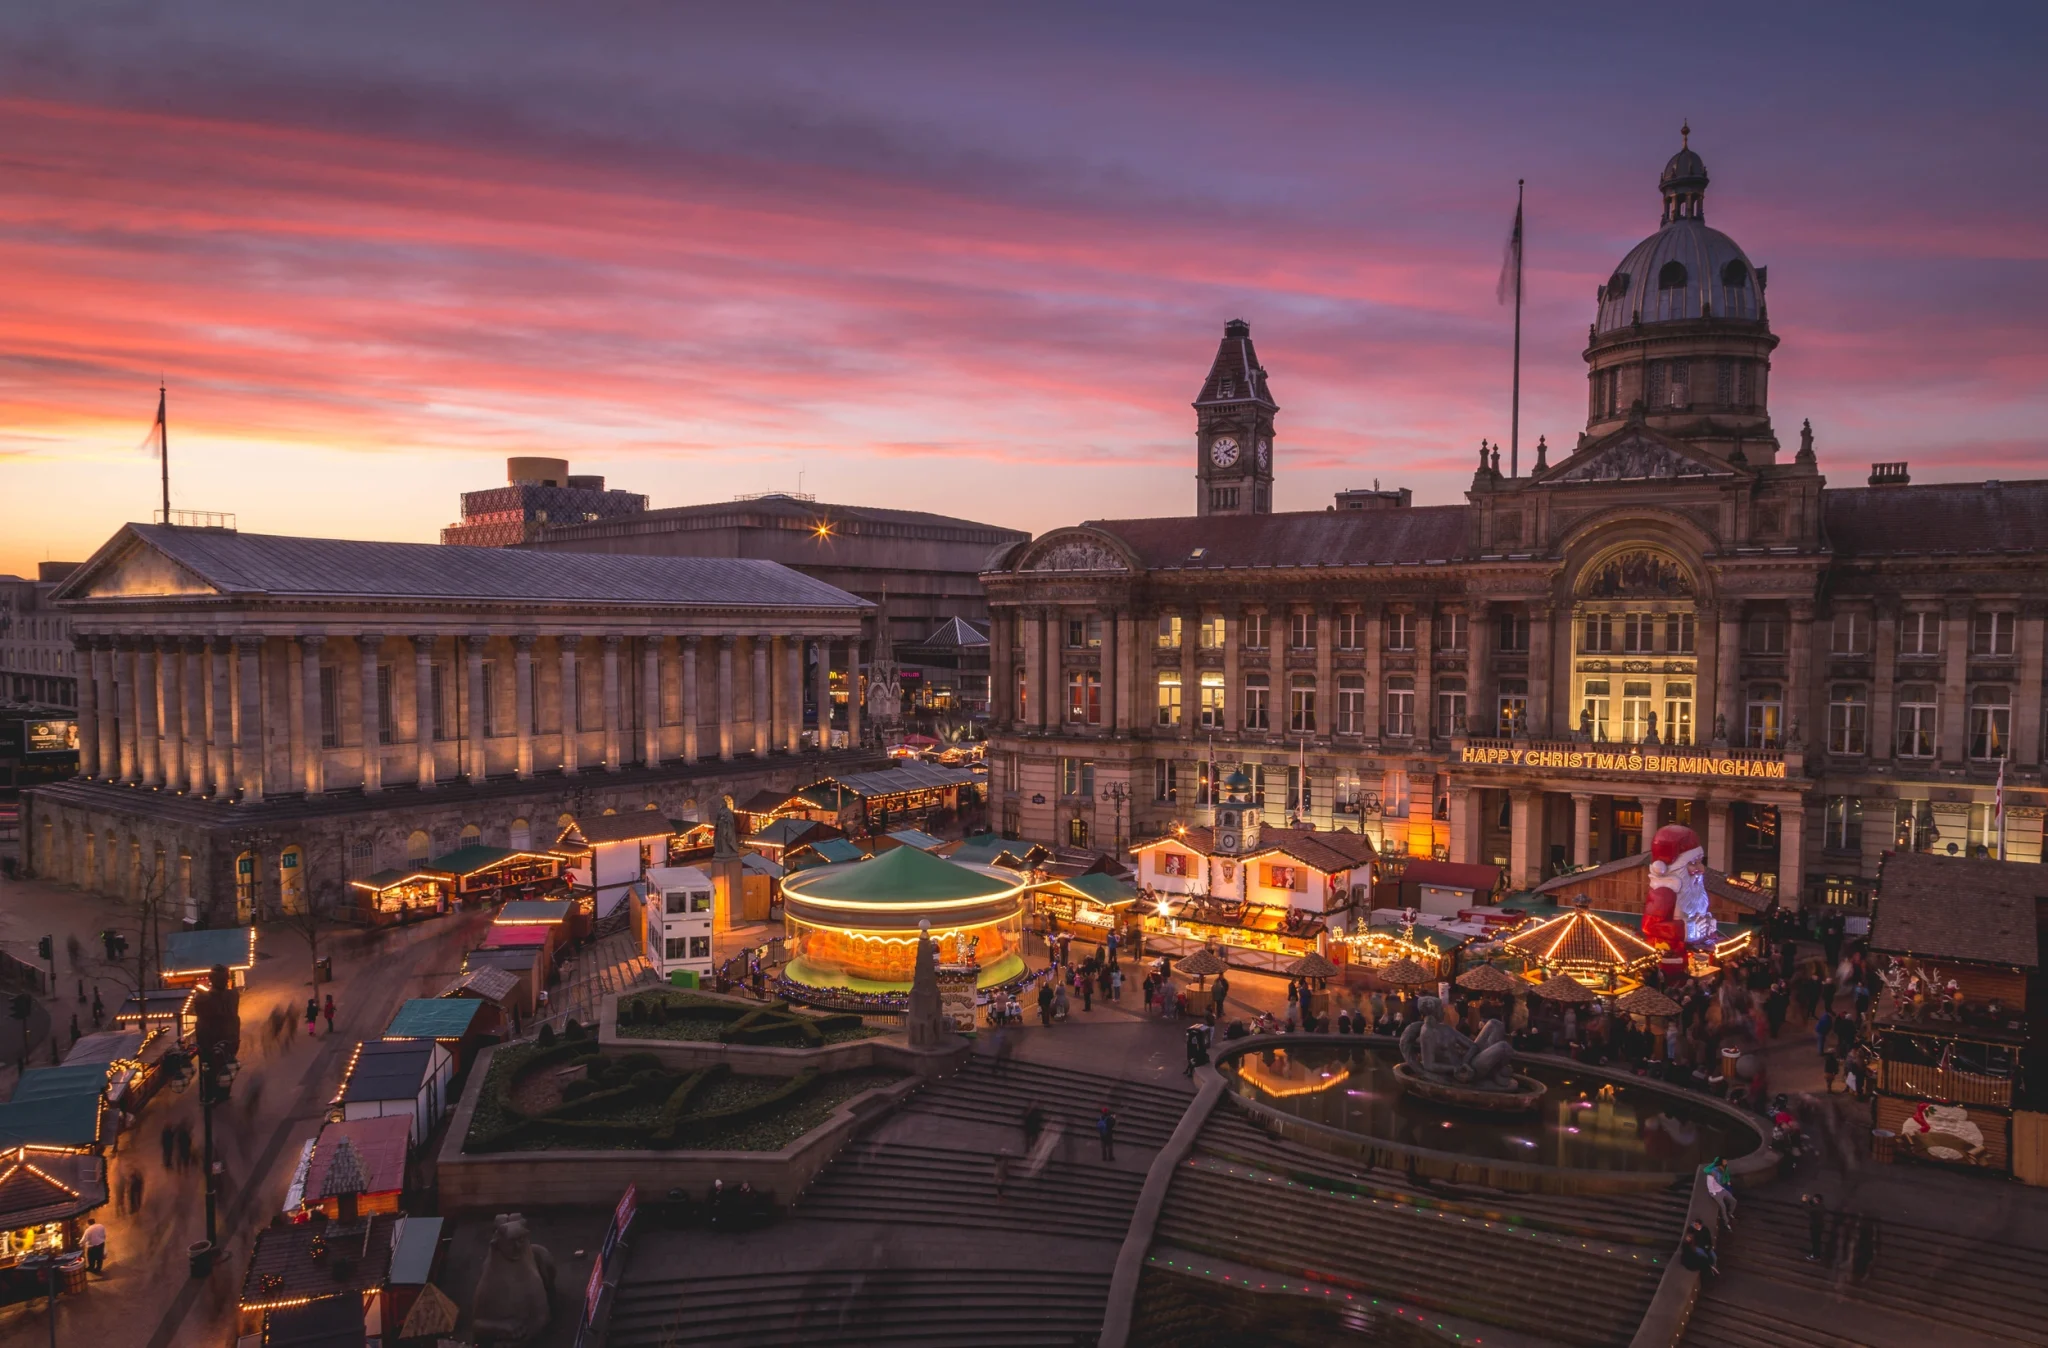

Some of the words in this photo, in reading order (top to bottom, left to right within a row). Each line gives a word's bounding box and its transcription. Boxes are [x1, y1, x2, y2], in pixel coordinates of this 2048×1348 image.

[1462, 747, 1523, 764] HAPPY
[1525, 750, 1643, 771] CHRISTMAS
[1645, 755, 1786, 778] BIRMINGHAM
